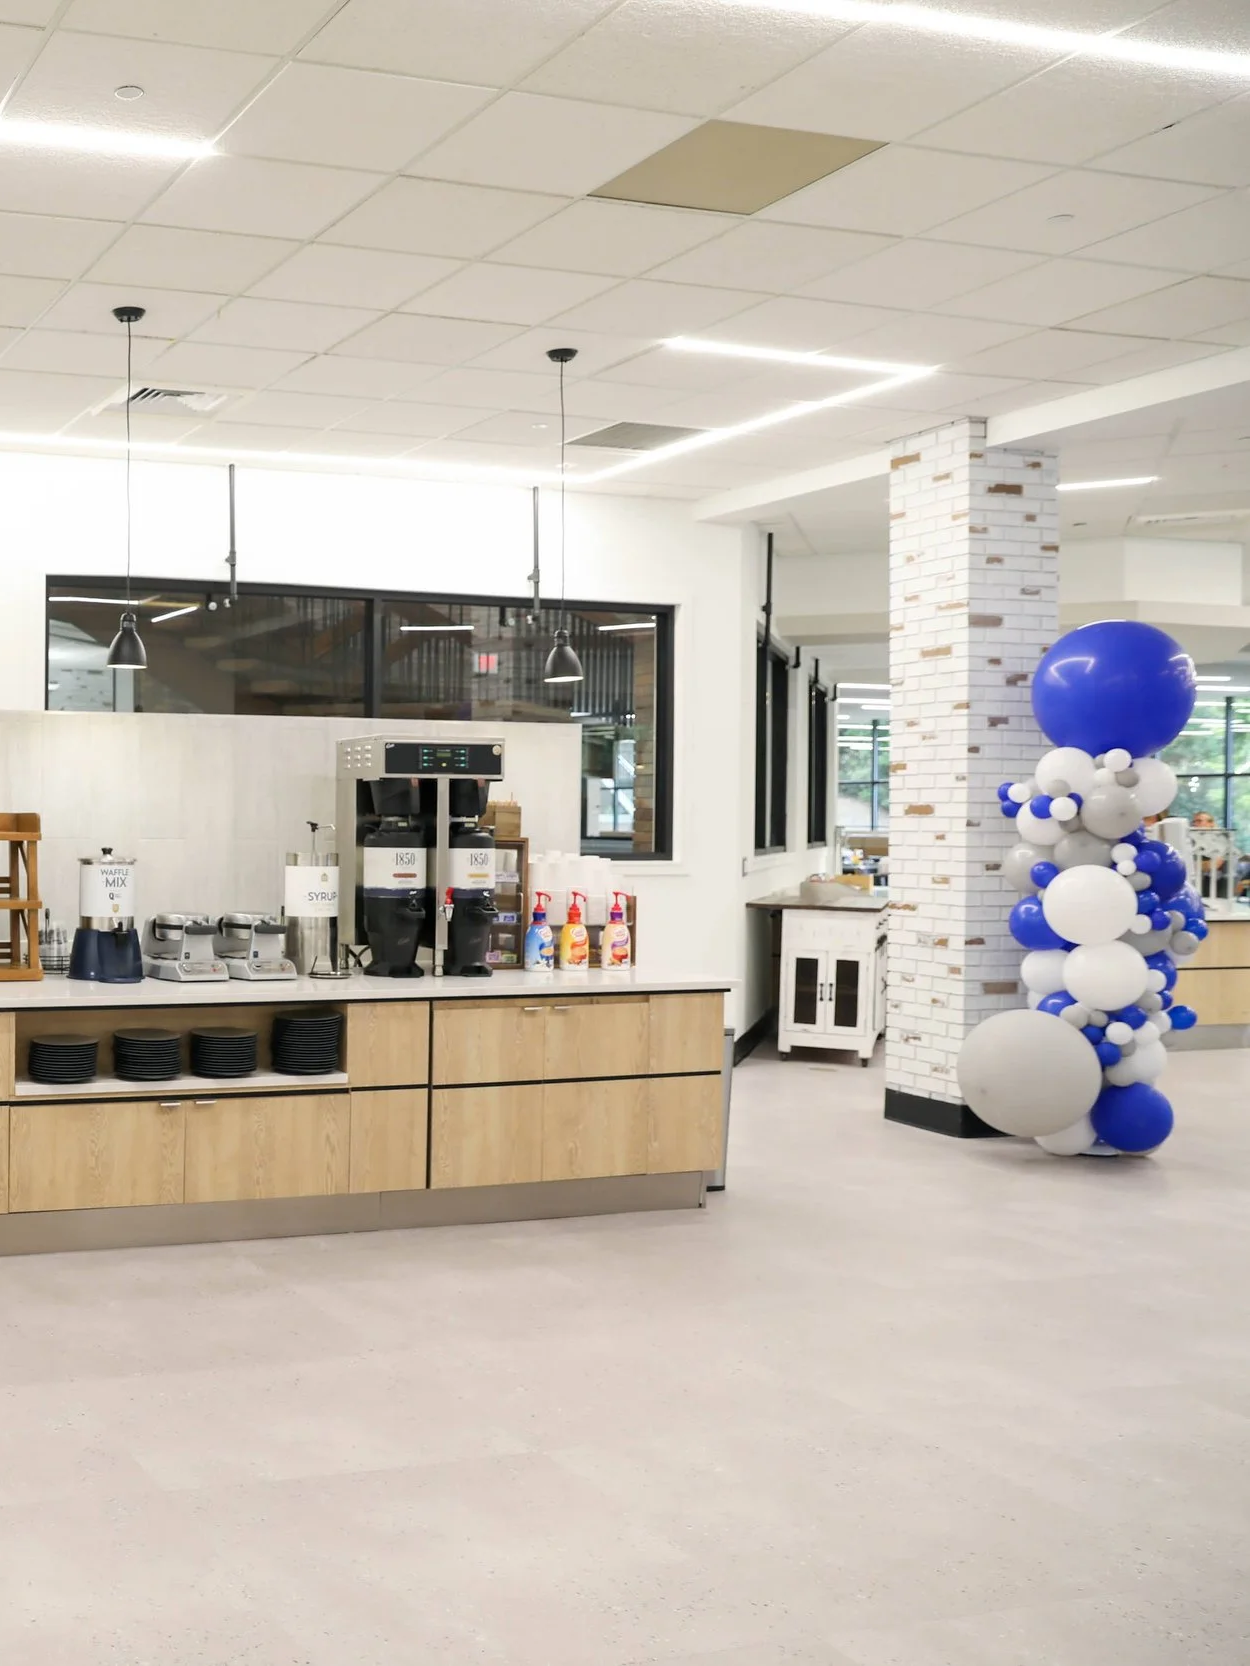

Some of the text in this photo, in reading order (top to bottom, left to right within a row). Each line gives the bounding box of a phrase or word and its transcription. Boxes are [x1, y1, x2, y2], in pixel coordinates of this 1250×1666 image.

[395, 852, 416, 866] 1850
[469, 852, 489, 866] 1850
[105, 876, 127, 888] MIX
[307, 891, 337, 901] SYRUP
